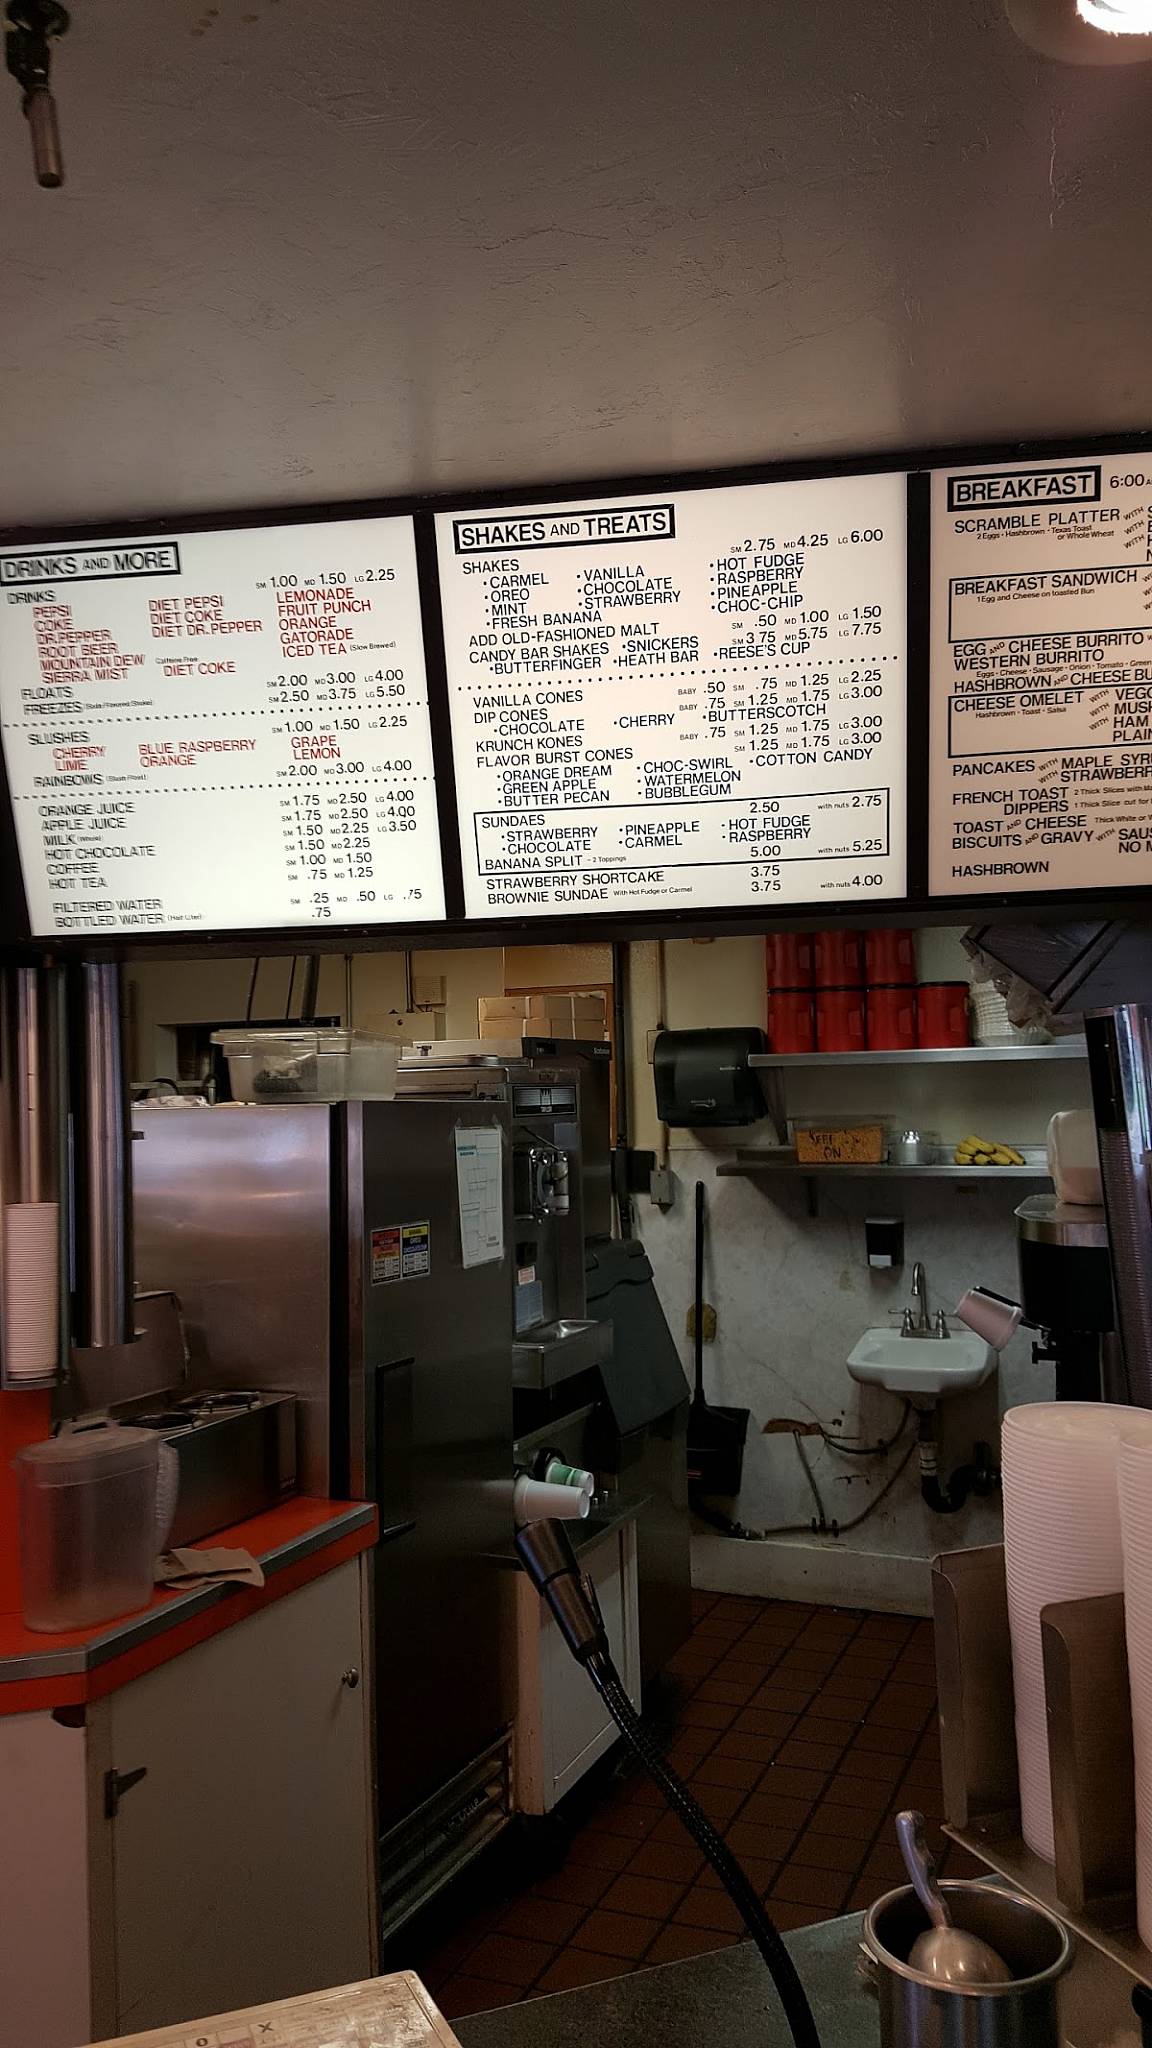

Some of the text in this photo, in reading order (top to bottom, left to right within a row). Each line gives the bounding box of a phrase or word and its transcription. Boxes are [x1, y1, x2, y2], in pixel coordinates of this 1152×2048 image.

[957, 475, 1091, 502] BREAKFAST
[1110, 474, 1144, 488] 6:00
[955, 509, 1120, 533] SCRAMBLE PLATTER
[1123, 507, 1144, 521] WITH
[462, 512, 666, 546] SHAKES AND TREATS
[1005, 529, 1045, 537] Hashbrown
[1091, 530, 1114, 538] Wheat
[744, 538, 775, 552] 2.75
[797, 534, 828, 547] 4.25
[851, 529, 883, 543] 6.00
[4, 551, 171, 578] DRINKS AND MORE
[463, 559, 519, 574] SHAKES
[717, 553, 805, 571] HOT FUDGE
[270, 575, 298, 588] 1.00
[319, 572, 346, 584] 1.50
[365, 569, 395, 582] 2.25
[490, 573, 549, 589] CARMEL
[584, 566, 644, 581] VANILLA
[717, 567, 803, 585] RASPBERRY
[584, 577, 673, 596] CHOCOLATE
[955, 570, 1137, 595] BREAKFAST SANDWICH
[7, 590, 56, 604] DRINKS
[149, 595, 224, 612] DIET PEPSI
[276, 588, 354, 604] LEMONADE
[491, 589, 530, 602] OREO
[585, 591, 681, 609] STRAWBERRY
[1013, 592, 1039, 600] Cheese
[33, 605, 71, 618] PEPSI
[278, 600, 371, 617] FRUIT PUNCH
[492, 603, 527, 616] MINT
[34, 619, 73, 632] COKE
[150, 610, 222, 625] DIET COKE
[279, 616, 337, 631] ORANGE
[493, 611, 602, 629] FRESH BANANA
[280, 628, 353, 644] GATORADE
[469, 623, 659, 647] ADD OLD-FASHIONED MALT
[38, 643, 119, 658] ROOT BEER
[283, 645, 314, 658] ICED
[319, 643, 347, 655] TEA
[627, 636, 699, 653] SNICKERS
[953, 632, 1143, 657] EGG AND CHEESE BURRITO
[469, 642, 609, 664] CANDY BAR SHAKES
[618, 650, 699, 667] HEATH BAR
[955, 649, 1104, 671] WESTERN BURRITO
[40, 654, 145, 671] MOUNTAIN DEW
[495, 657, 601, 674] BUTTERFINGER
[954, 670, 1131, 693] HASHBROWN AND CHEESE
[21, 686, 73, 700] FLOATS
[473, 690, 583, 709] VANILLA CONES
[954, 691, 1084, 712] CHEESE OMELET
[474, 708, 548, 724] DIP CONES
[619, 713, 675, 728] CHERRY
[708, 704, 826, 722] BUTTERSCOTCH
[1113, 716, 1149, 728] HAM
[28, 731, 90, 745] SLUSHES
[291, 735, 337, 748] GRAPE
[476, 736, 583, 752] KRUNCH KONES
[138, 739, 256, 755] BLUE RASPBERRY
[293, 747, 340, 760] LEMON
[477, 748, 633, 768] FLAVOR BURST CONES
[644, 757, 733, 774] CHOC-SWIRL
[756, 748, 873, 767] COTTON CANDY
[1062, 755, 1113, 769] MAPLE
[503, 765, 612, 782] ORANGE DREAM
[953, 760, 1035, 776] PANCAKES
[645, 770, 741, 786] WATERMELON
[503, 779, 596, 794] GREEN APPLE
[645, 784, 732, 799] BUBBLEGUM
[504, 790, 610, 807] BUTTER PECAN
[852, 795, 882, 807] 2.75
[953, 787, 1069, 805] FRENCH TOAST
[38, 802, 135, 816] ORANGE JUICE
[1004, 801, 1068, 815] DIPPERS
[482, 814, 545, 828] SUNDAES
[952, 831, 1094, 849] BISCUITS AND GRAVY
[47, 862, 99, 875] COFFEE
[485, 855, 583, 870] BANANA SPLIT
[952, 861, 1049, 877] HASHBROWN
[487, 871, 664, 890] STRAWBERRY SHORTCAKE
[488, 888, 608, 904] BROWNIE SUNDAE
[53, 899, 163, 913] FILTERED WATER
